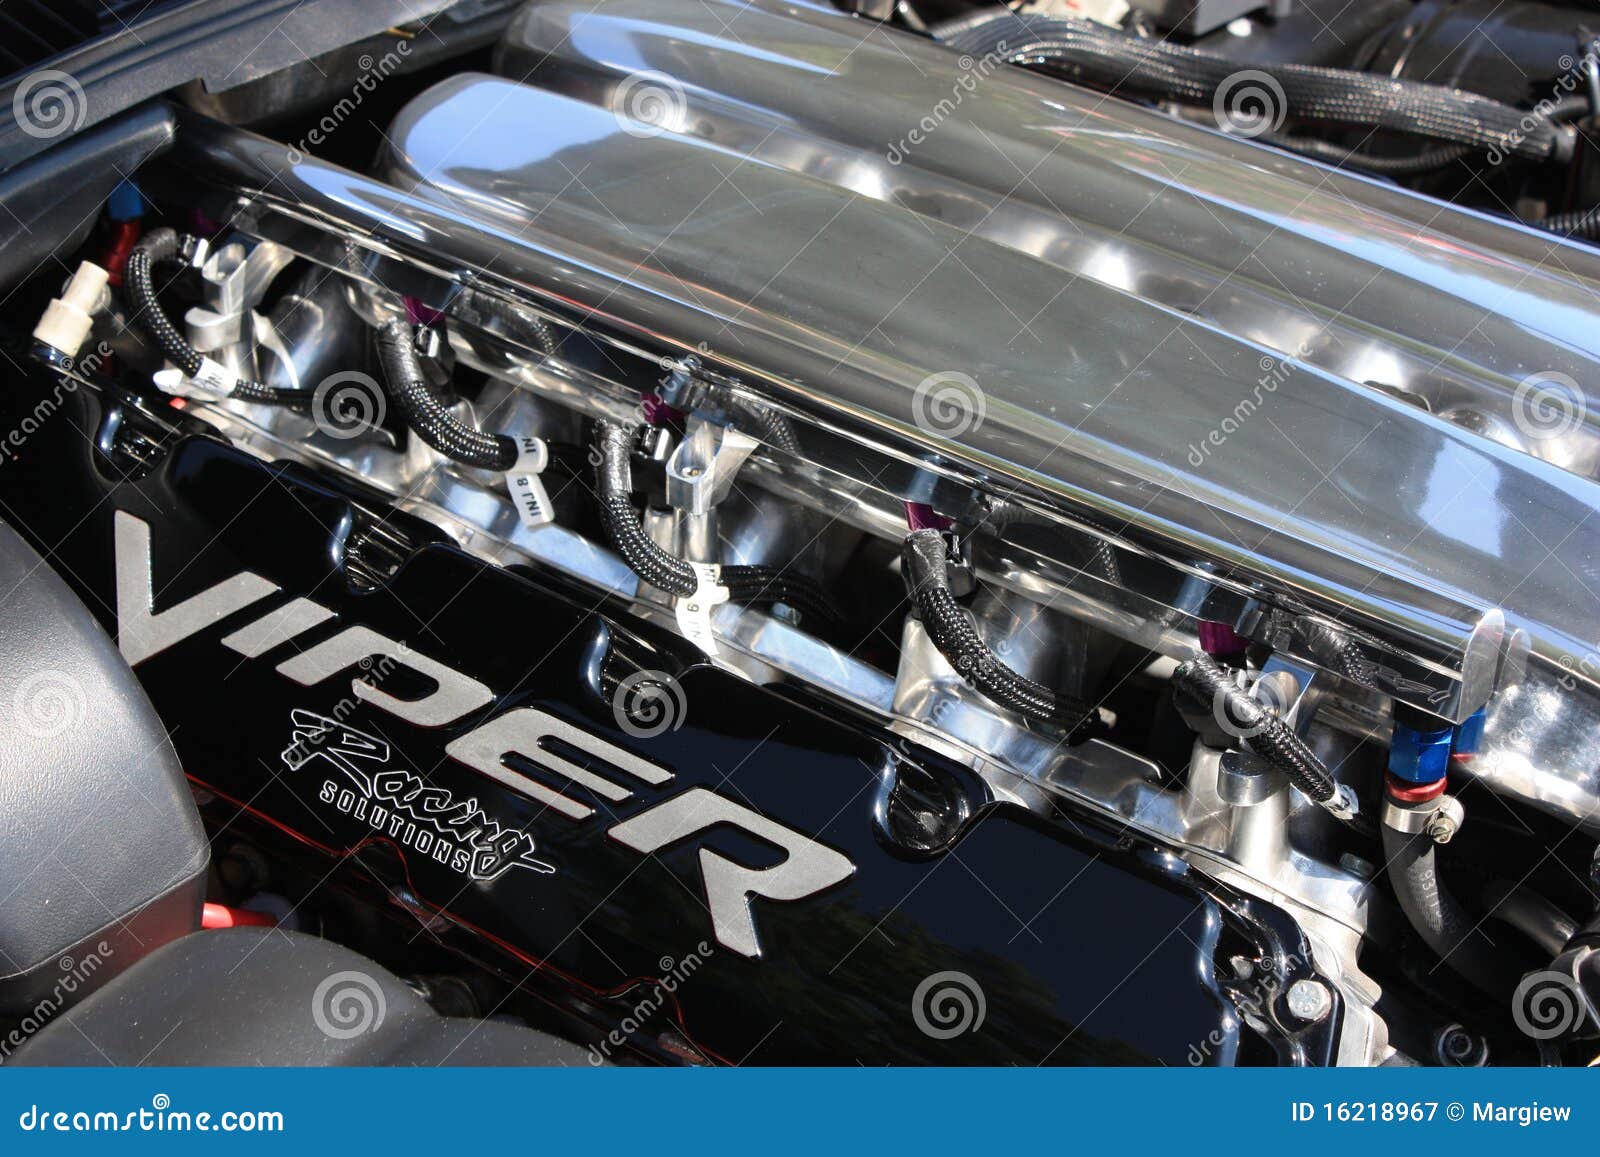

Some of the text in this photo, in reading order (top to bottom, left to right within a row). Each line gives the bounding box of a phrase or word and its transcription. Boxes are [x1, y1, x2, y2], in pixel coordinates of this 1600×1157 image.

[521, 438, 537, 454] IN
[516, 477, 543, 517] INJ 8
[114, 509, 858, 959] VIPER
[281, 708, 556, 880] Racing
[319, 779, 471, 874] SOLUTIONS
